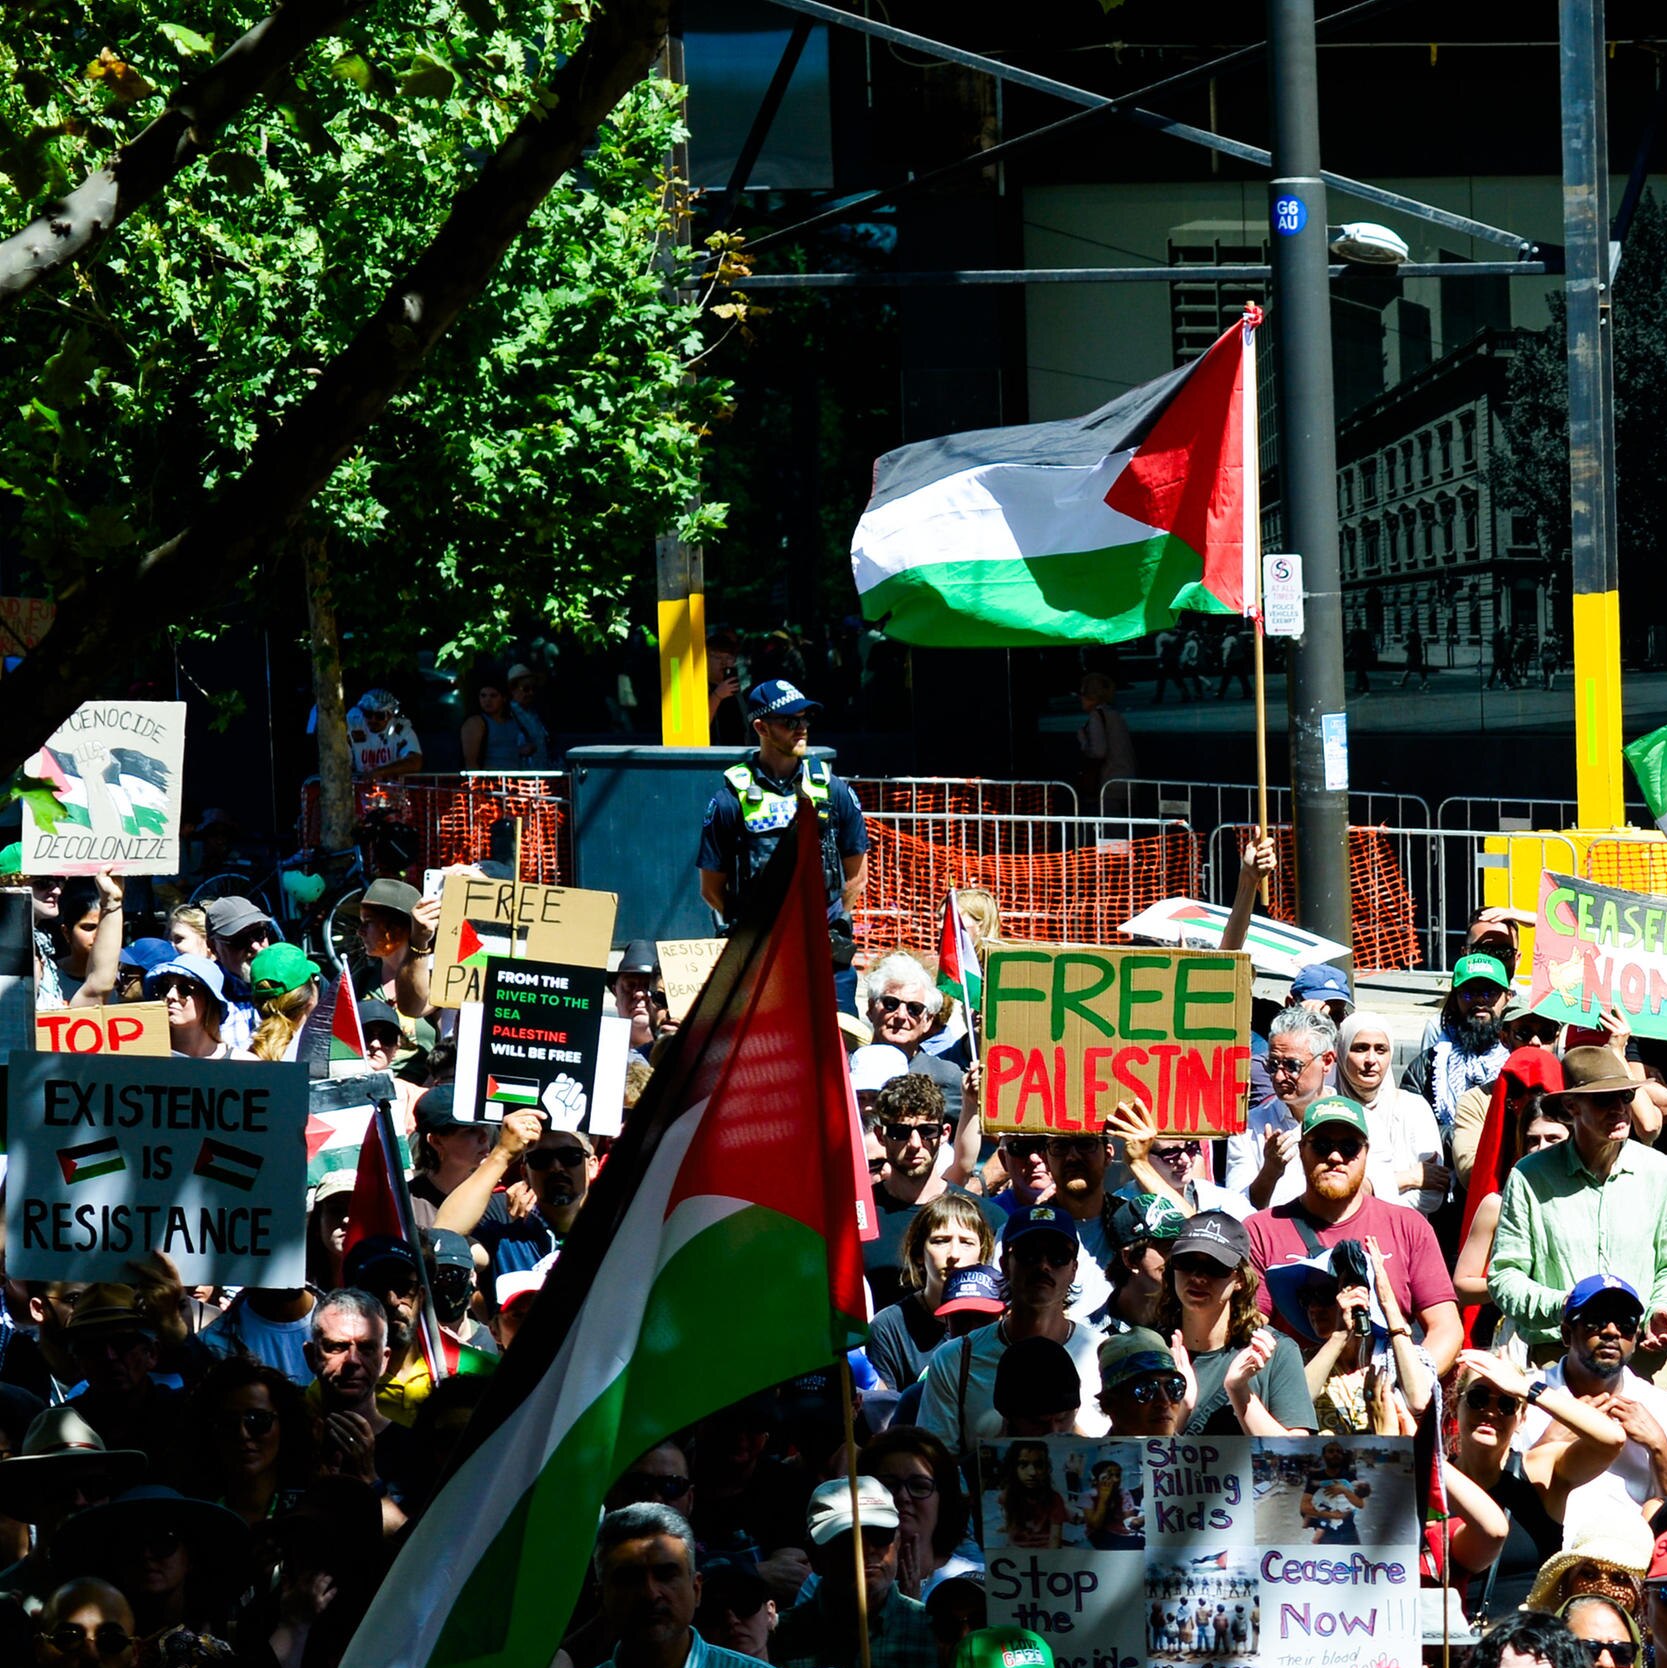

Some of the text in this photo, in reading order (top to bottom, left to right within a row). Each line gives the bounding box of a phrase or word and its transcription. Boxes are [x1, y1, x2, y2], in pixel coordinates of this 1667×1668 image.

[1277, 200, 1298, 214] G6
[1278, 216, 1298, 230] AU
[69, 707, 166, 743] GENOCIDE
[34, 835, 172, 862] DECOLONIZE
[464, 880, 565, 924] FREE
[497, 970, 570, 989] FROM THE
[684, 962, 700, 973] IS
[496, 989, 590, 1010] RIVER TO THE
[985, 950, 1236, 1043] FREE
[494, 1007, 520, 1020] SEA
[492, 1024, 567, 1043] PALESTINE
[491, 1043, 583, 1064] WILL BE FREE
[986, 1043, 1250, 1132] PALESTINE
[44, 1078, 270, 1132] EXISTENCE
[143, 1146, 173, 1181] IS
[22, 1198, 273, 1256] RESISTANCE
[1147, 1439, 1219, 1474] Stop
[1261, 1551, 1407, 1585] Ceasefire
[991, 1556, 1098, 1612] Stop
[1013, 1604, 1075, 1635] the
[1280, 1602, 1378, 1640] Now
[1003, 1650, 1045, 1668] GAZA
[1278, 1645, 1361, 1666] Their blood
